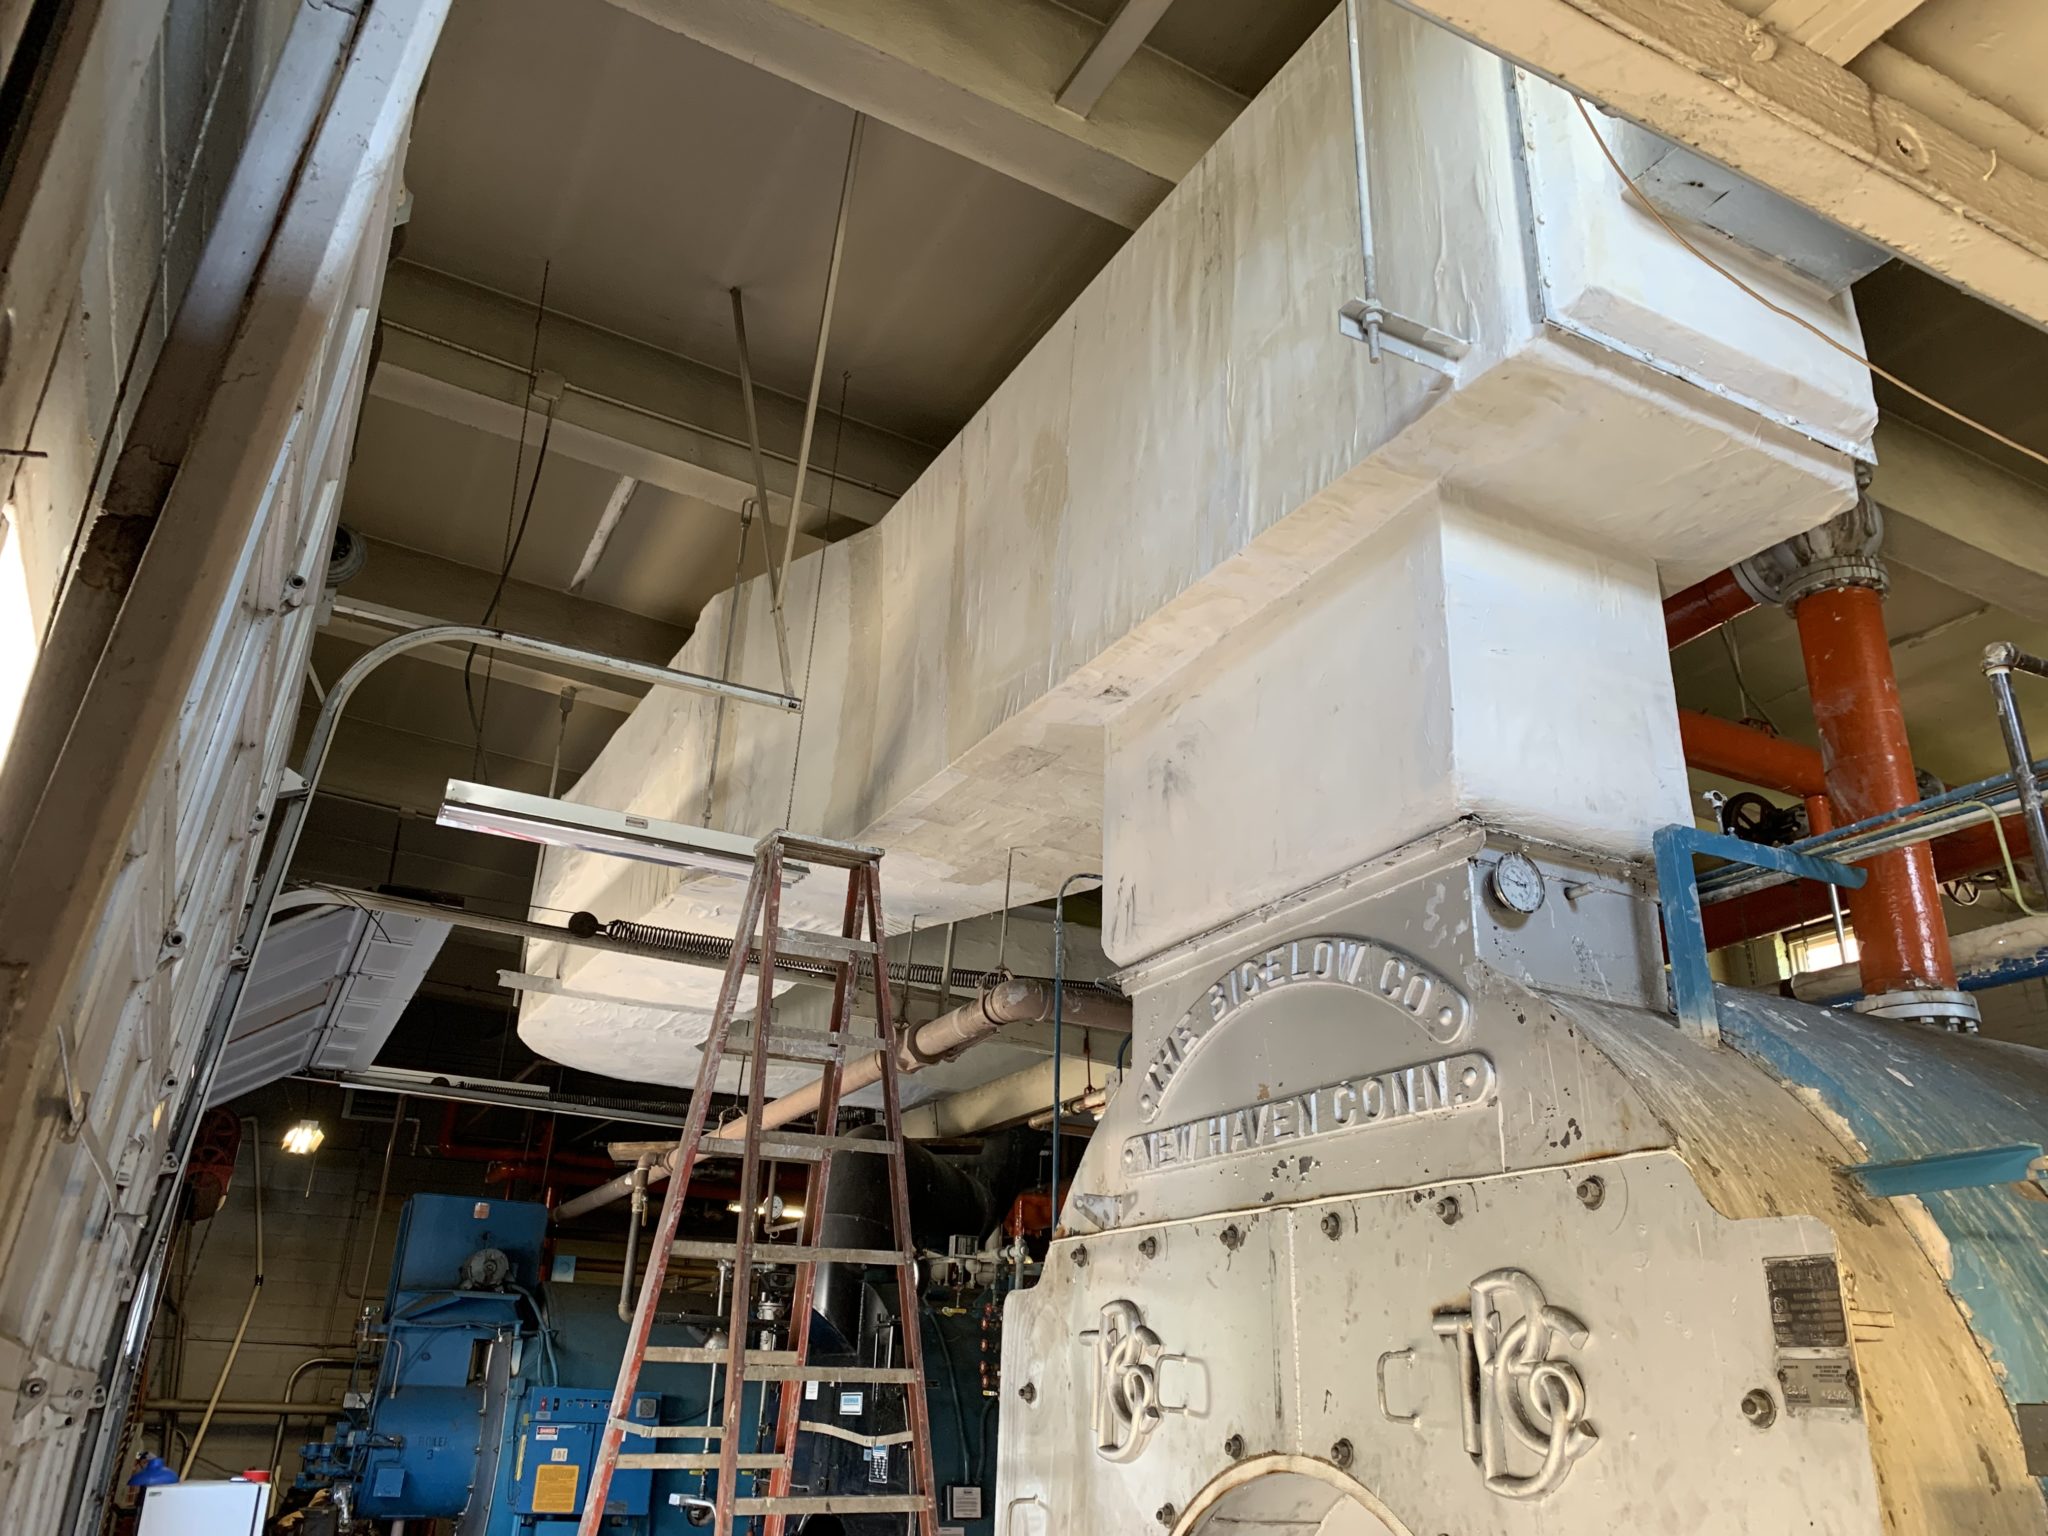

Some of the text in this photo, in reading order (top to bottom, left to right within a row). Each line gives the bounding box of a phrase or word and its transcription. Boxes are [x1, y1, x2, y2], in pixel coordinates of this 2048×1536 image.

[1144, 1010, 1199, 1093] THE
[1207, 939, 1367, 1022] BIGELOW
[1140, 1123, 1198, 1171] NEW
[1208, 1090, 1319, 1155] HAVEN
[426, 1448, 434, 1460] 3
